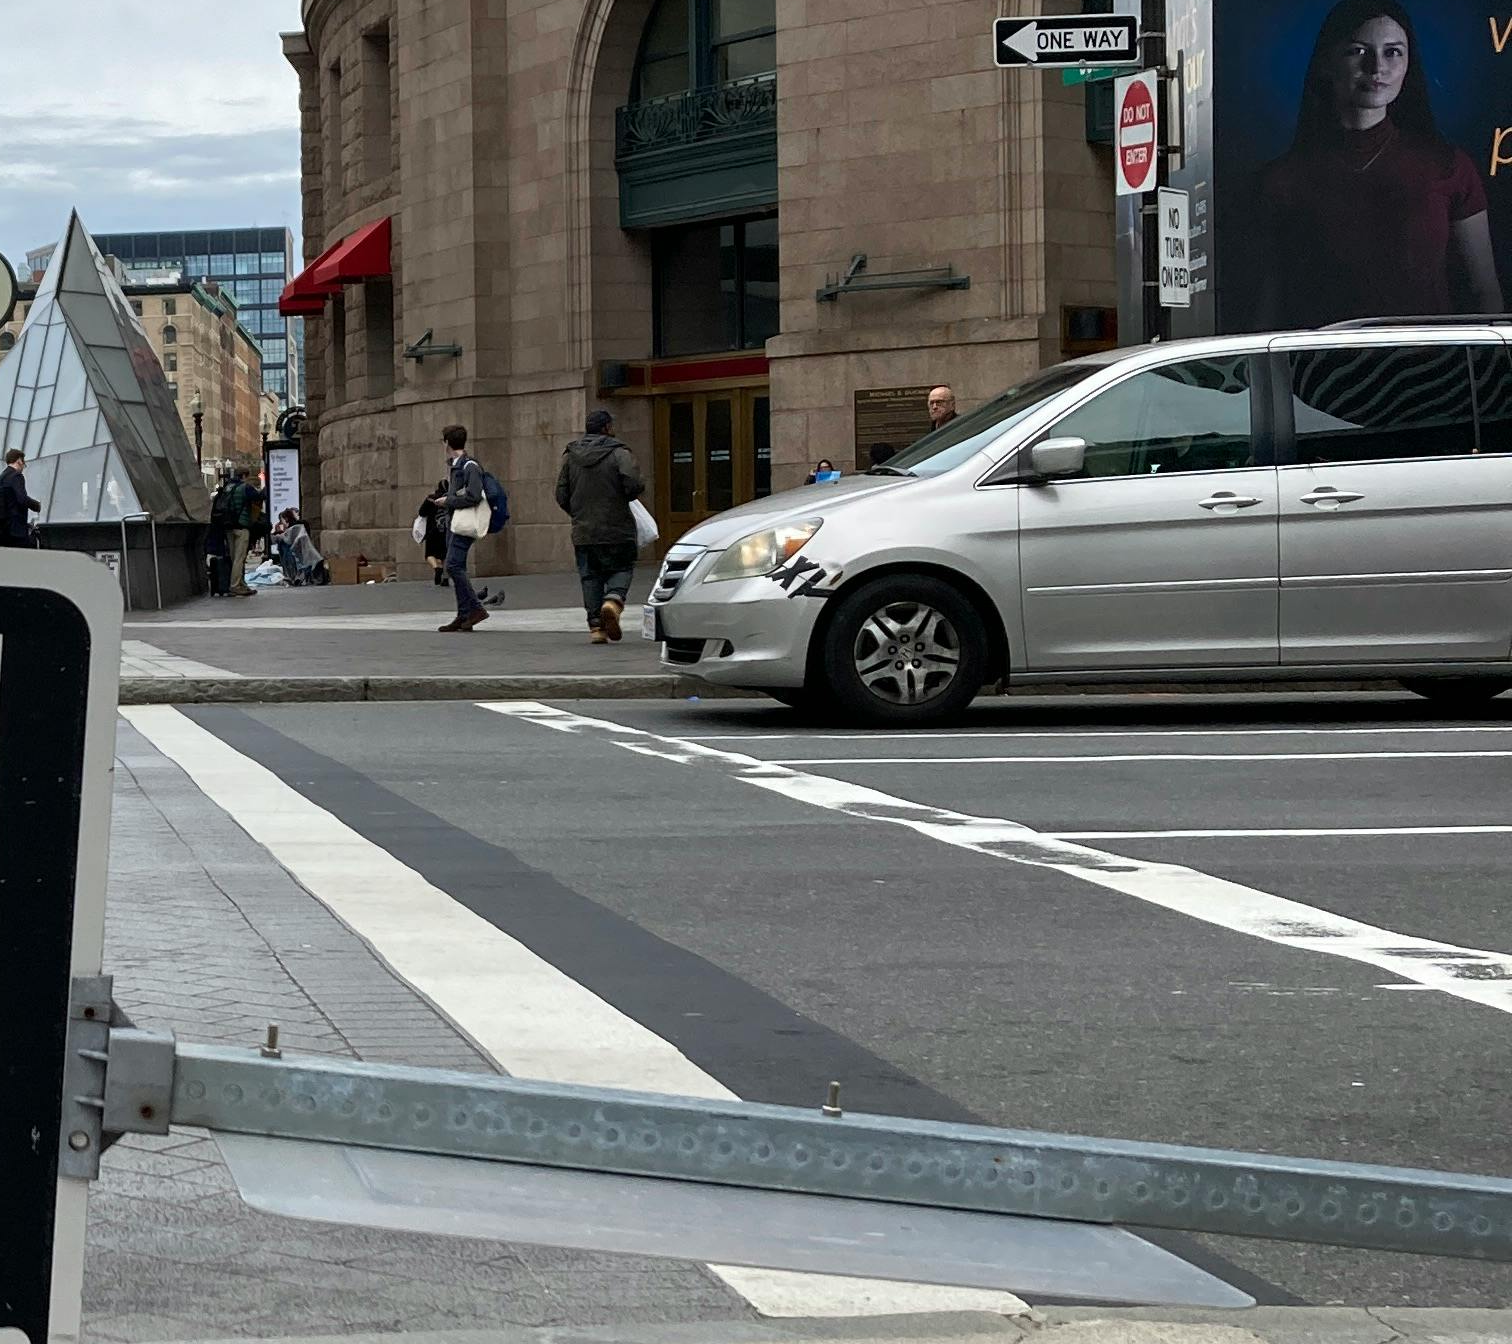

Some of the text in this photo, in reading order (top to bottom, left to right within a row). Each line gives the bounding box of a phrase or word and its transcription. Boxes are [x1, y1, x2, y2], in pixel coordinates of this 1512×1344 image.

[1037, 29, 1124, 50] ONE WAY
[1123, 103, 1151, 124] DO NOT
[1168, 208, 1180, 230] NO
[1165, 237, 1185, 260] TURN
[1162, 266, 1173, 288] ON
[1174, 267, 1188, 288] RED
